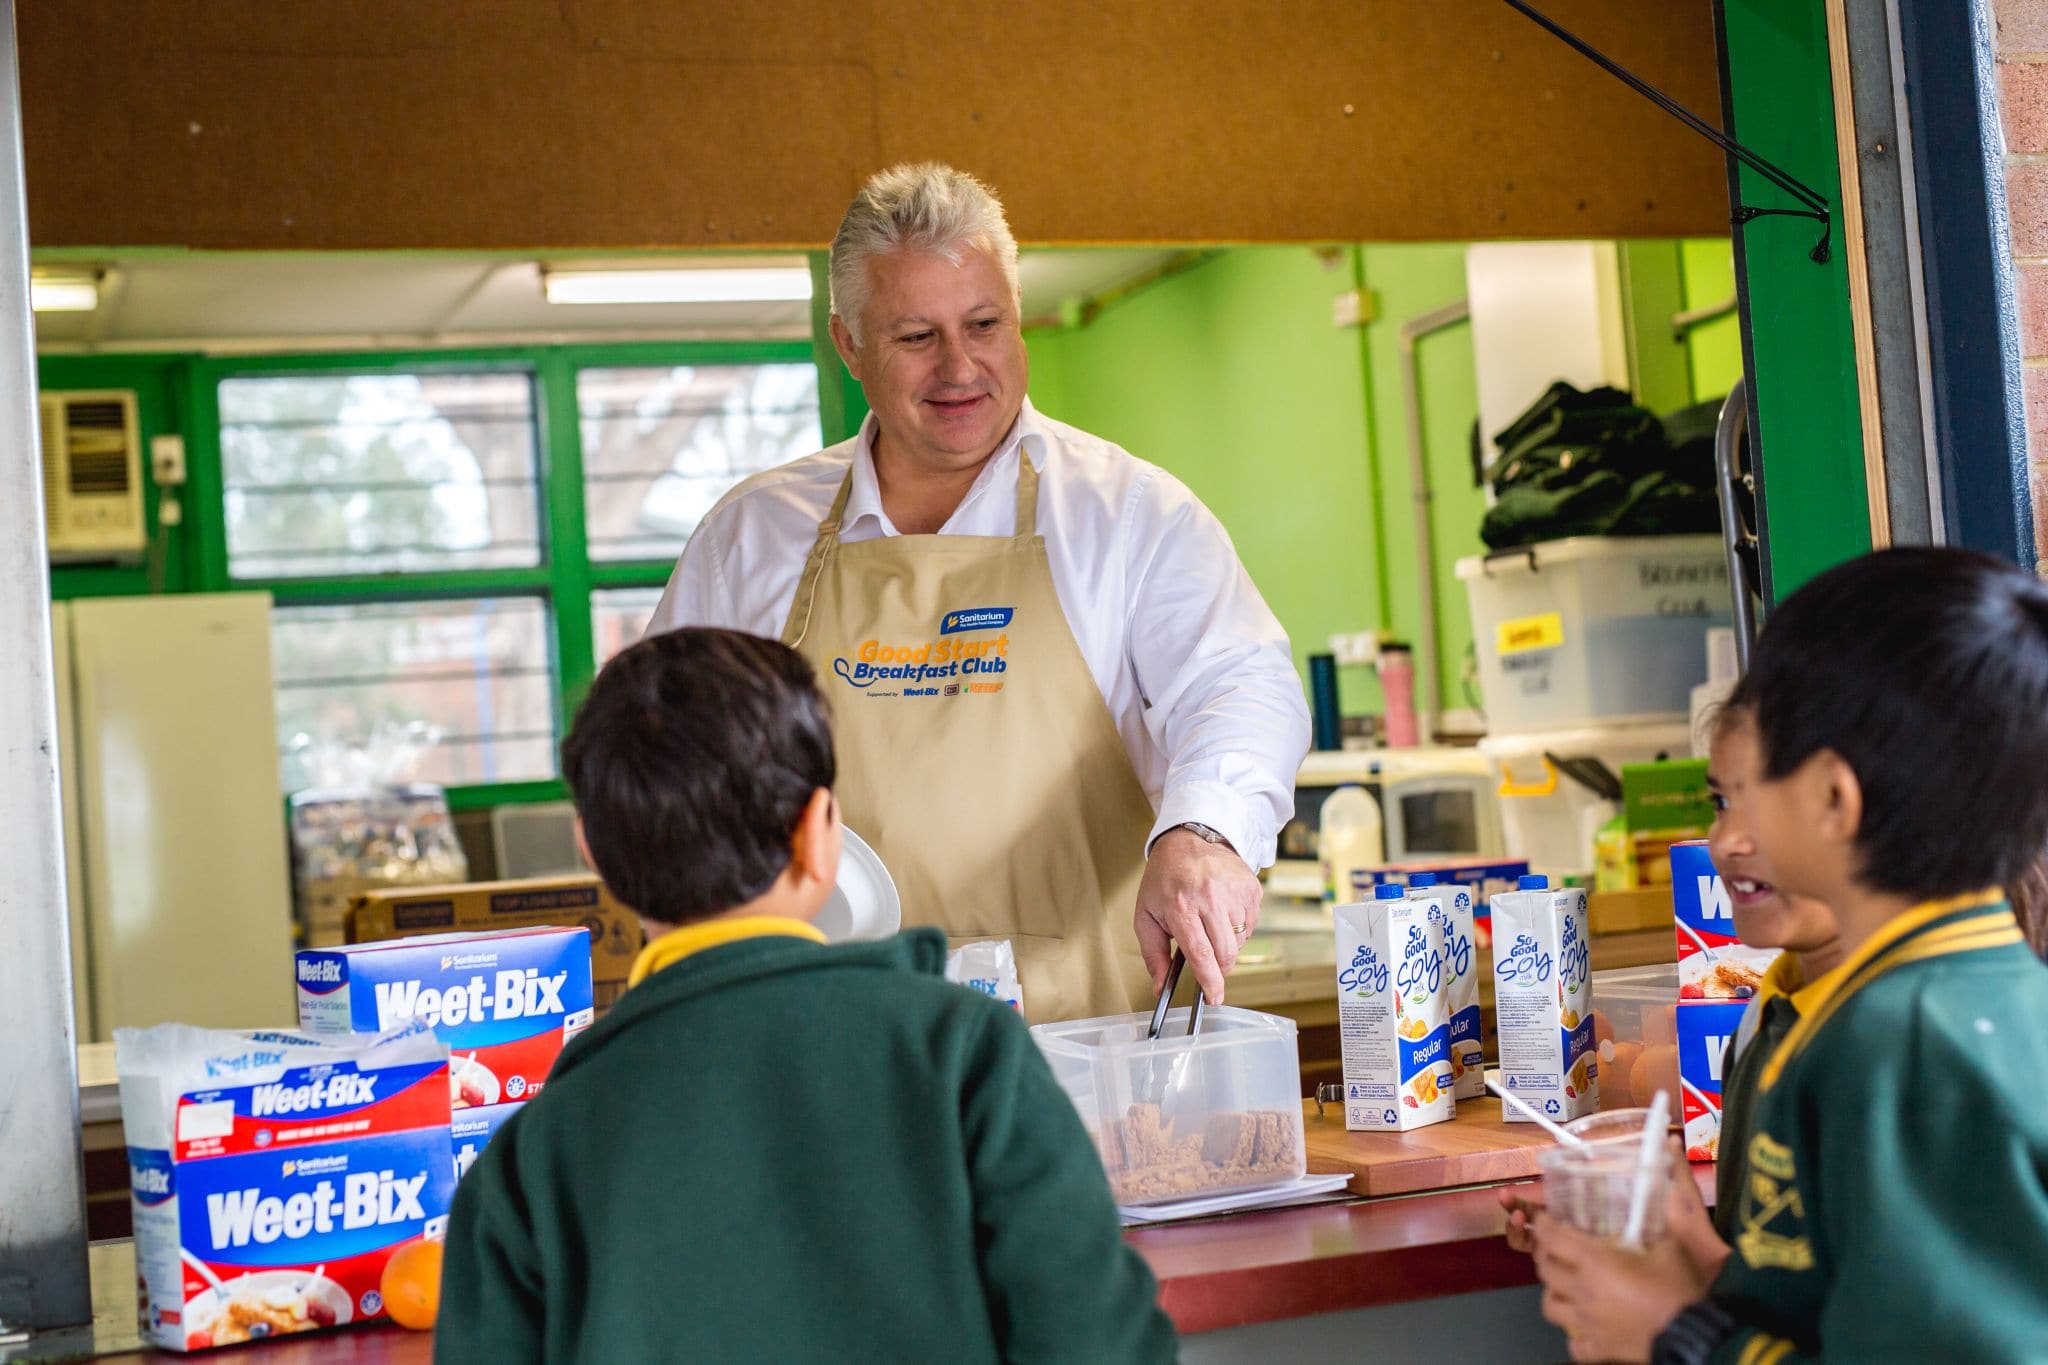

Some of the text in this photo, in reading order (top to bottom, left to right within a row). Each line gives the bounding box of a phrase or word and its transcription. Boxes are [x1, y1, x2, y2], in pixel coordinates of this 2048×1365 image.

[960, 612, 1004, 624] Sanitarium
[858, 634, 1009, 663] Good Start
[854, 656, 1007, 683] Breakfast Club
[1408, 925, 1422, 944] So
[1564, 914, 1574, 933] So
[1405, 935, 1426, 959] Good
[1516, 934, 1532, 947] So
[1562, 924, 1577, 949] Good
[453, 953, 498, 966] Sanitarium
[1352, 952, 1377, 967] Good
[1356, 945, 1372, 958] So
[1511, 942, 1538, 957] Good
[298, 959, 342, 982] Weet-Bix
[375, 968, 567, 1032] Weet-Bix
[1413, 1039, 1441, 1065] Regular
[1570, 1029, 1590, 1056] Regular
[252, 1073, 378, 1117] Weet-Bix
[207, 1169, 427, 1250] Weet-Bix
